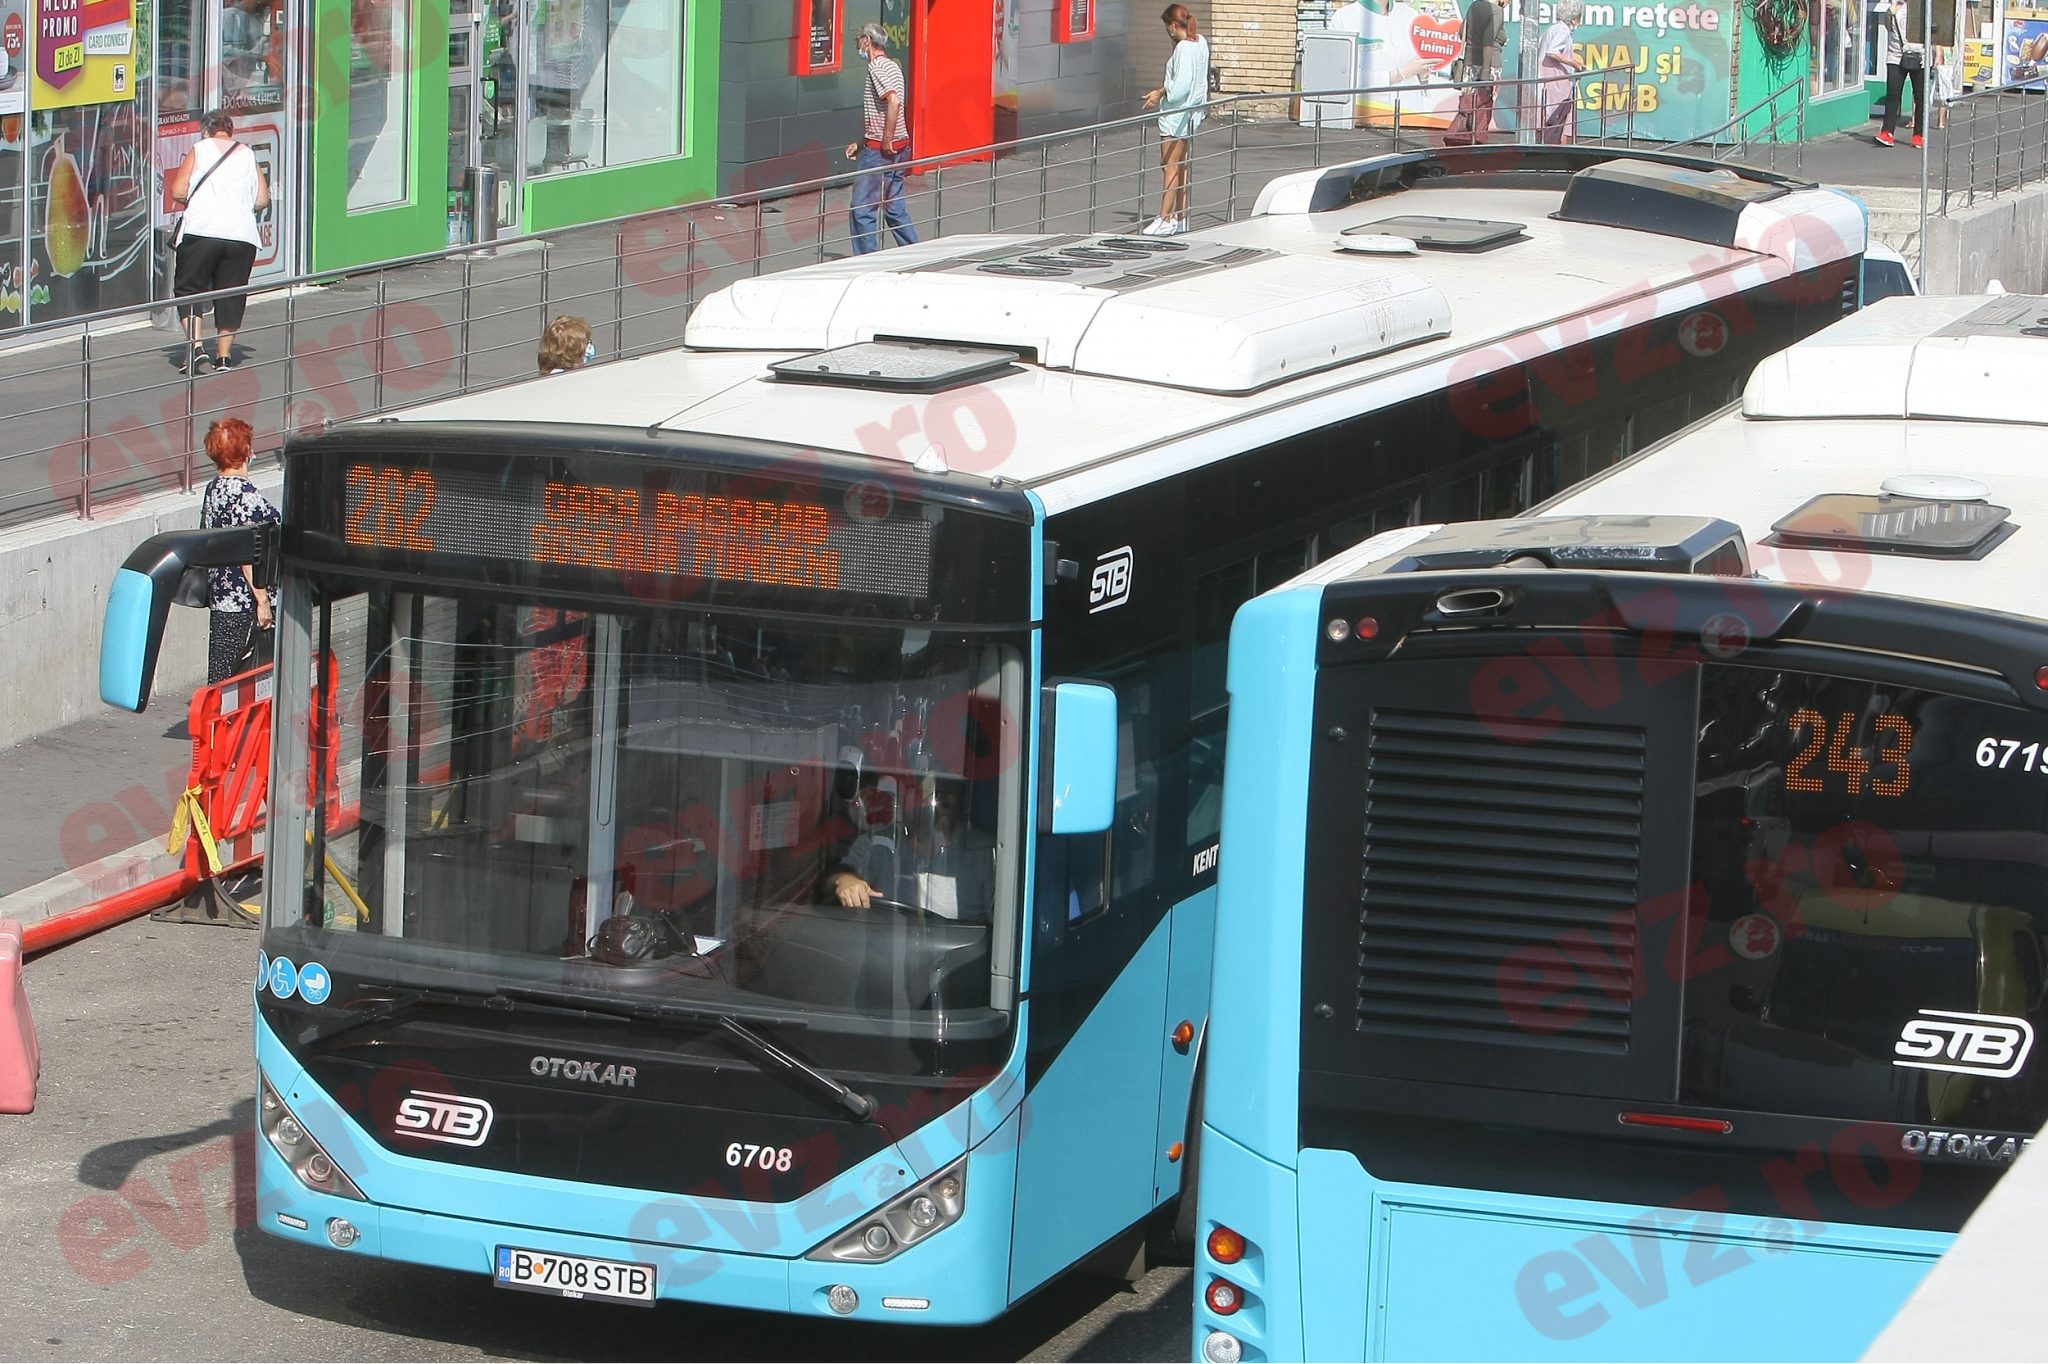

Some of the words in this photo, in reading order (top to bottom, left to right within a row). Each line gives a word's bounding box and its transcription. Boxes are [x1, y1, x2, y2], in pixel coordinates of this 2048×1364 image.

[42, 16, 78, 38] PROMO
[1623, 3, 1719, 37] rețete
[88, 35, 103, 49] CARD
[104, 33, 128, 47] CONNECT
[1420, 41, 1454, 55] inimii
[1655, 45, 1682, 83] și
[345, 464, 436, 551] 282
[544, 481, 640, 528] GARA
[656, 491, 830, 546] BASARAB
[692, 540, 841, 590] FUNDENI
[1089, 557, 1130, 604] STB
[1787, 709, 1912, 797] 243
[1193, 844, 1219, 876] KENT
[1895, 1019, 2020, 1064] STB
[530, 1056, 637, 1087] OTOKAR
[395, 1097, 484, 1136] STB
[726, 1143, 793, 1173] 6708
[515, 1253, 533, 1280] B
[543, 1257, 588, 1288] 708
[594, 1265, 647, 1295] STB
